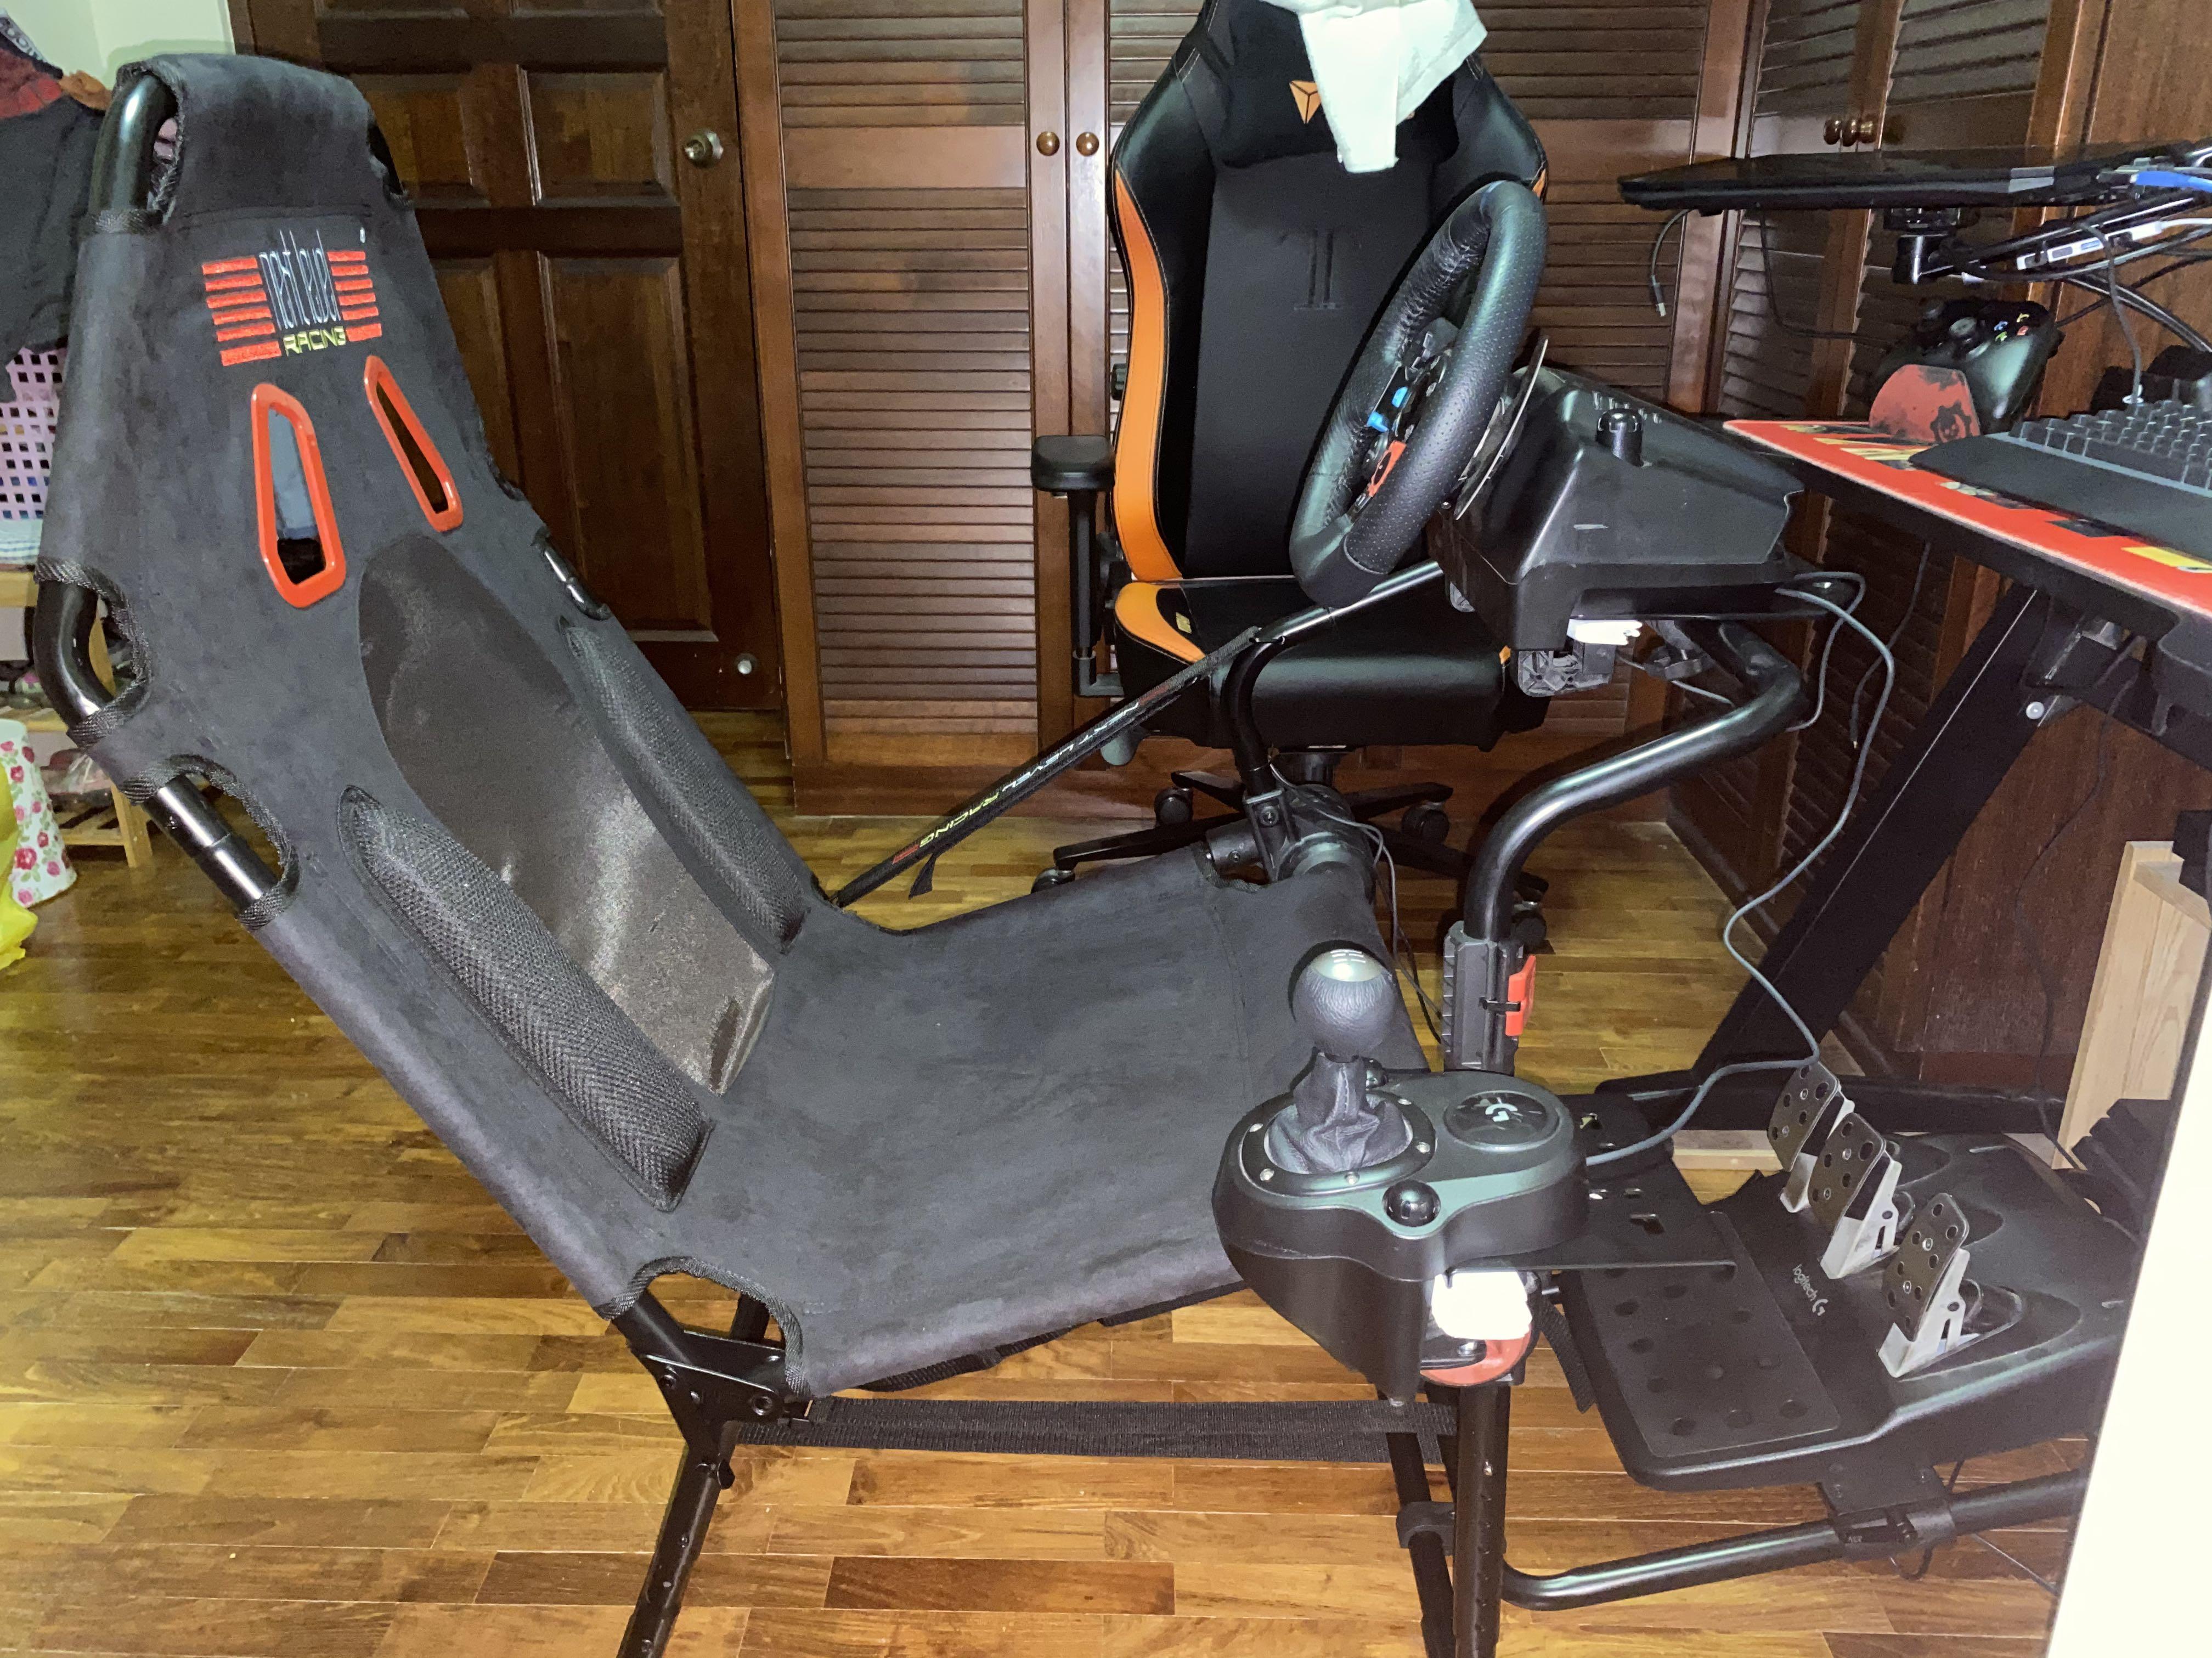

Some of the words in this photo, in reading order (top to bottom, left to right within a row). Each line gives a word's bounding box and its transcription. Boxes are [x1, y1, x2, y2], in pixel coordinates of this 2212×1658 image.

[283, 326, 346, 357] RACING
[919, 792, 999, 847] RACING
[1792, 1264, 1818, 1301] logitech
